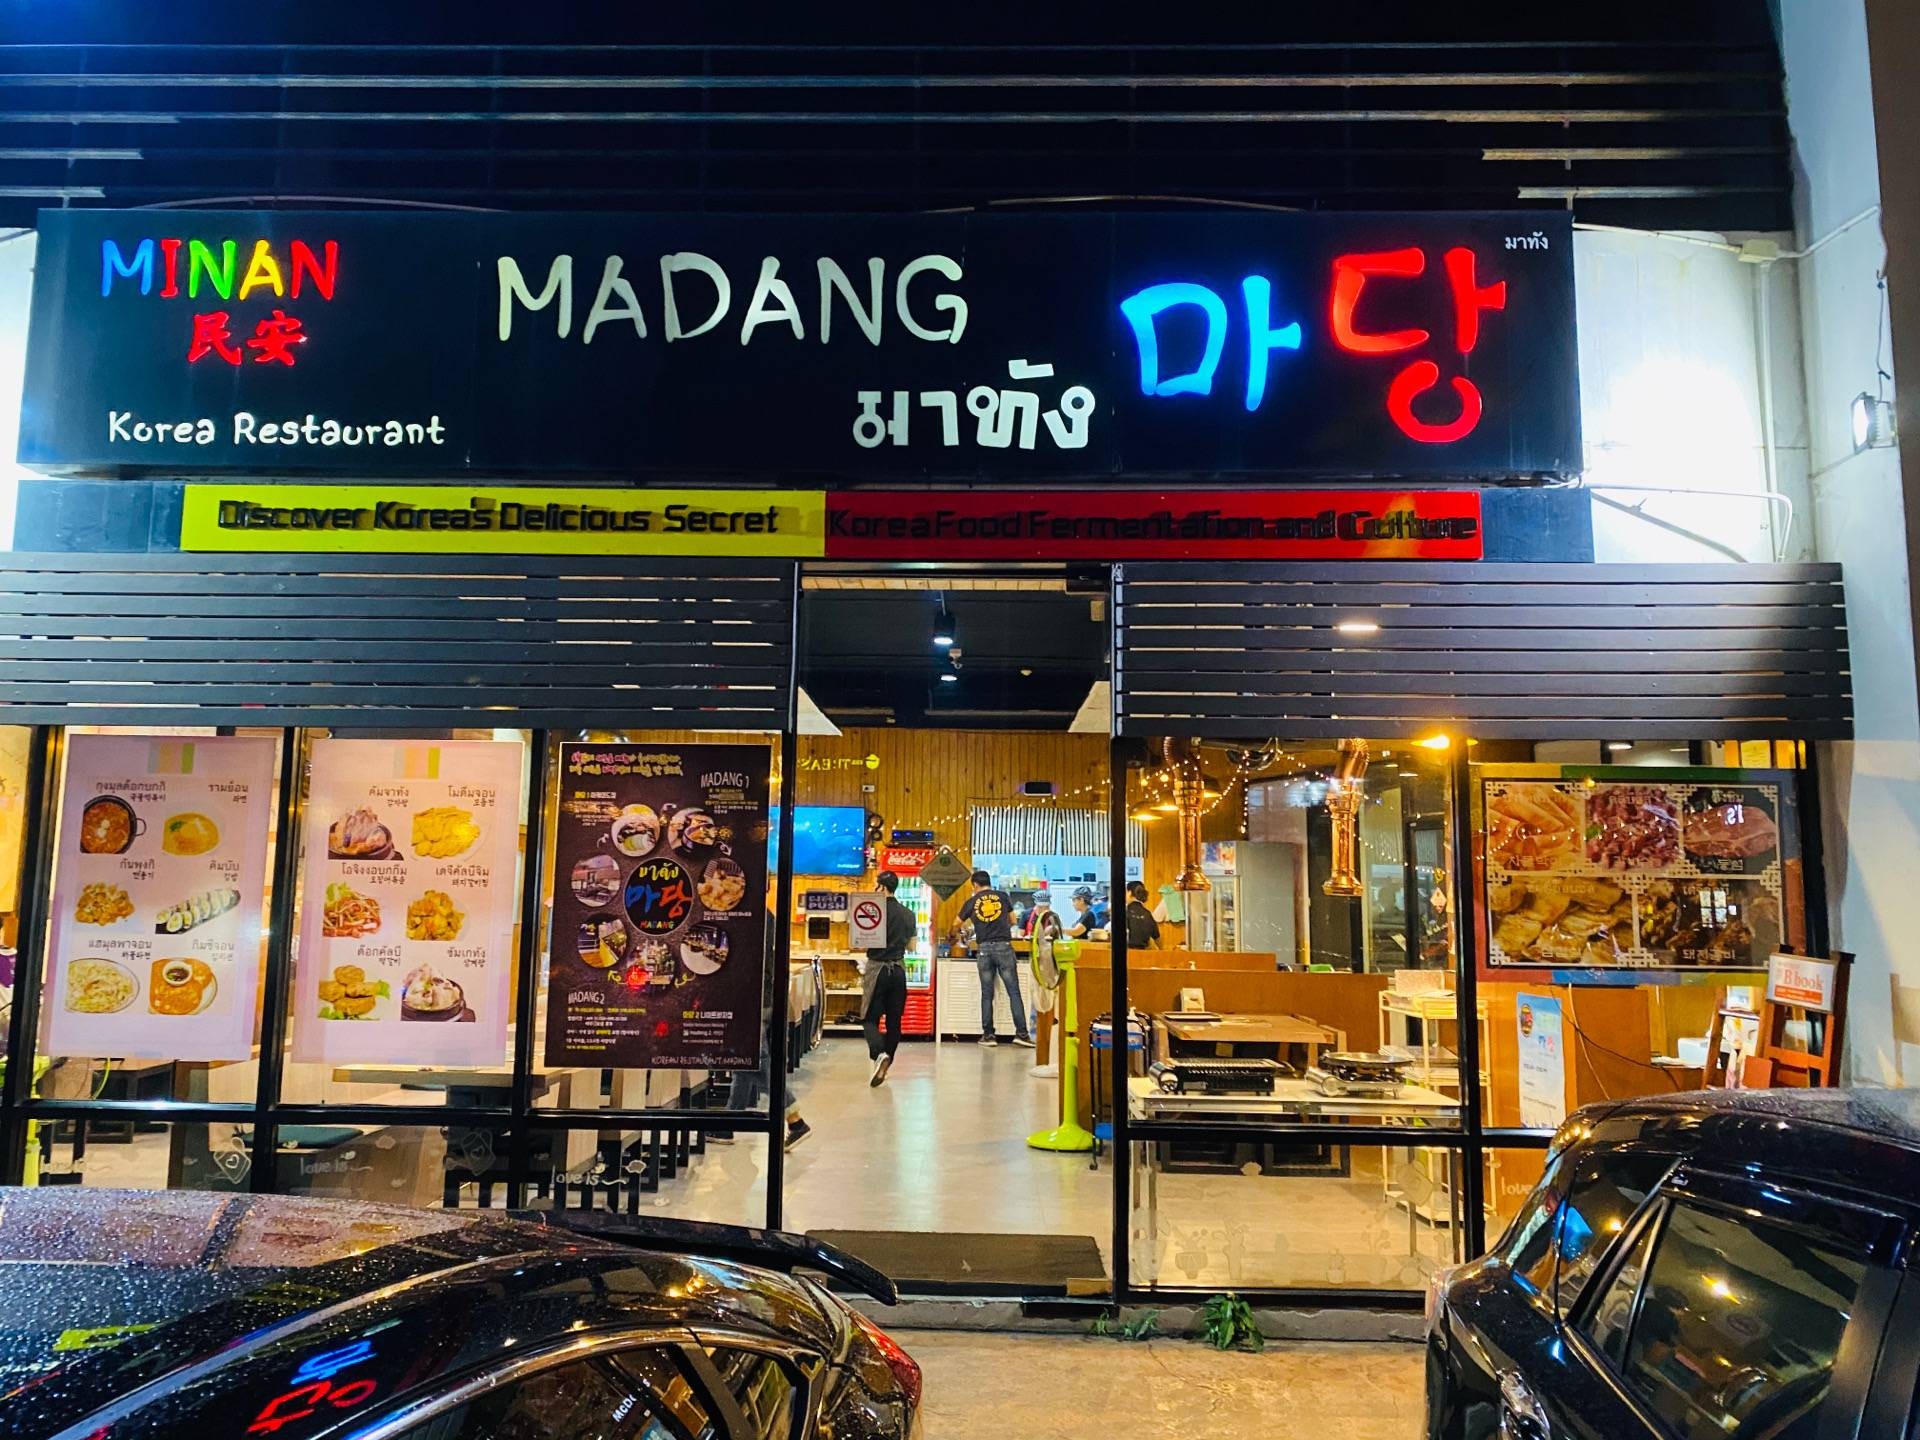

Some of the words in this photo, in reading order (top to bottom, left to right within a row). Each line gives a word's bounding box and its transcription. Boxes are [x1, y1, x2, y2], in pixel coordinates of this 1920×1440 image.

[1505, 232, 1548, 249] มาทัง
[101, 237, 338, 300] MINAN
[498, 254, 968, 345] MADANG
[187, 310, 308, 367] 民安
[1120, 243, 1507, 443] 마당
[853, 359, 1095, 449] มาทัง
[109, 411, 215, 444] Korea
[234, 412, 446, 446] Restaurant
[218, 500, 362, 530] Discover
[499, 502, 650, 531] Delicious
[664, 504, 778, 534] Secret
[829, 509, 930, 538] Korea
[936, 509, 1021, 538] Food
[1028, 509, 1265, 539] Fermentation
[1276, 509, 1336, 539] and
[1337, 509, 1478, 540] Culture
[700, 771, 743, 789] MADANG
[808, 902, 845, 910] PUSH
[568, 991, 599, 1004] MADANG
